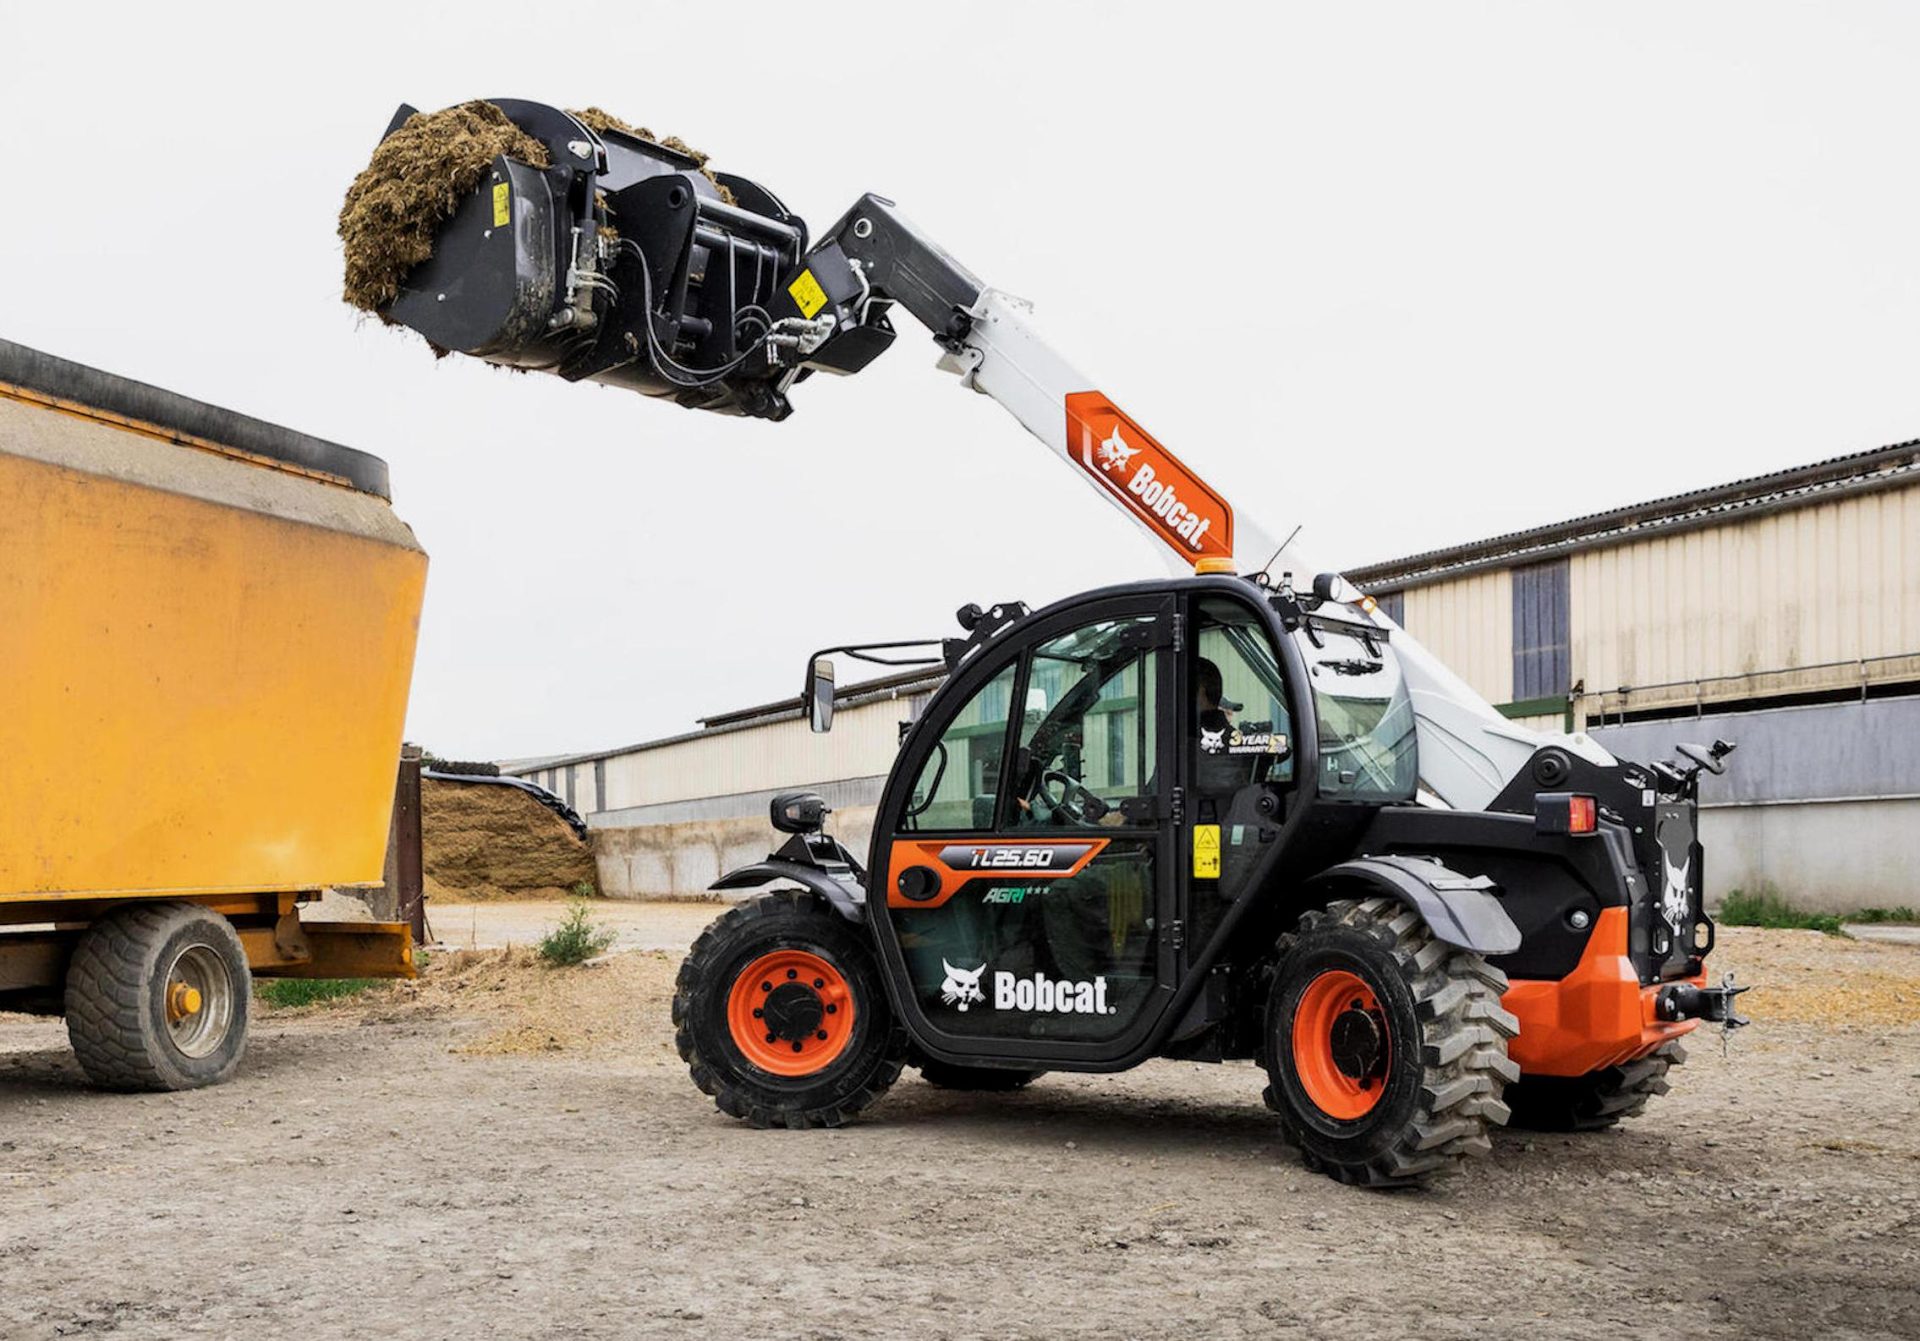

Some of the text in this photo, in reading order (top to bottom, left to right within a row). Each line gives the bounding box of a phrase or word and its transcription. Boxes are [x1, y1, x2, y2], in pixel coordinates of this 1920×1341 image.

[1127, 463, 1211, 547] Bobcat
[1229, 730, 1269, 746] 3 YEAR
[971, 849, 1054, 867] TL25.60
[982, 887, 1025, 904] AGRI
[995, 971, 1107, 1014] Bobcat
